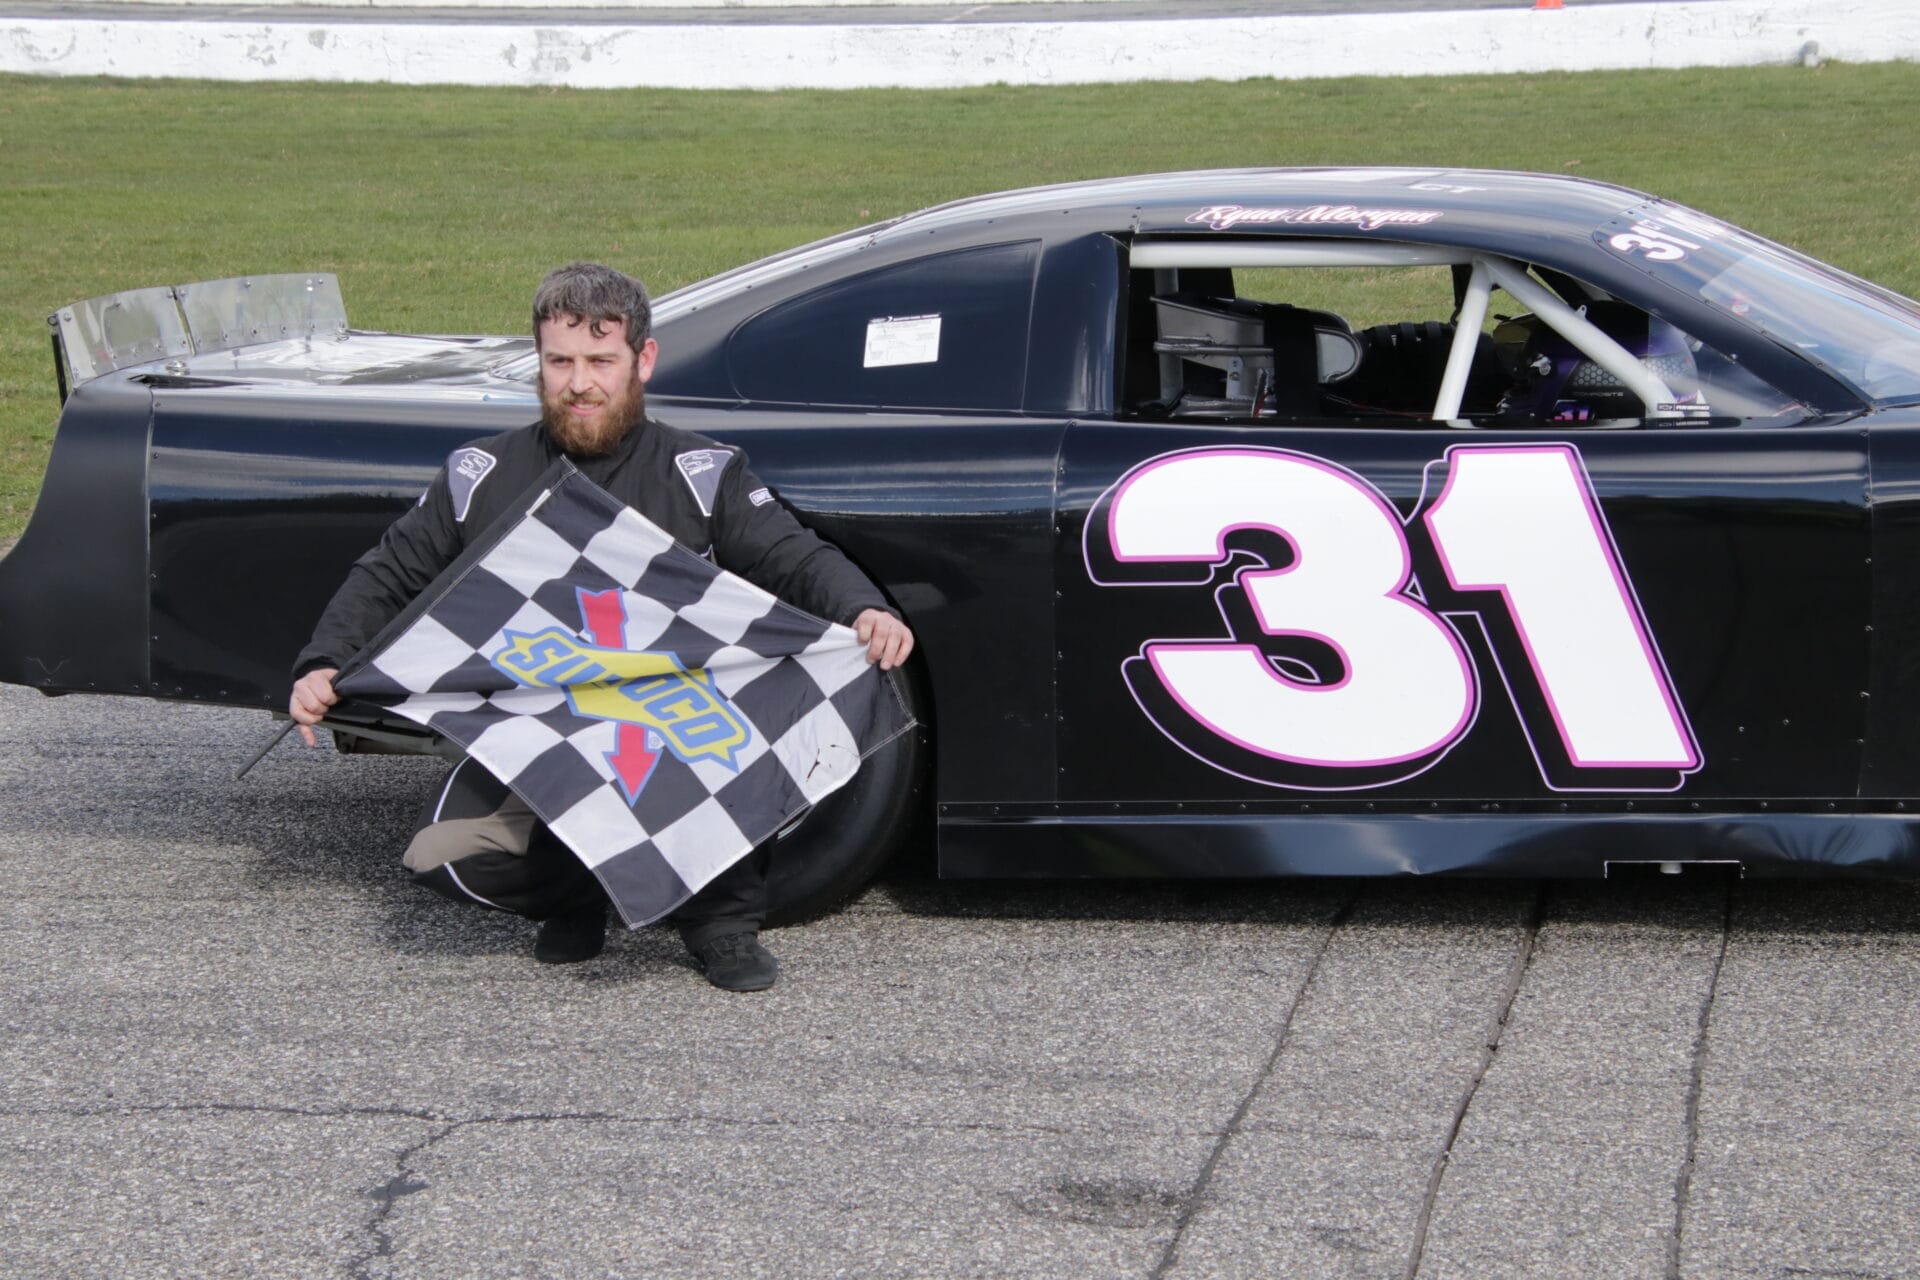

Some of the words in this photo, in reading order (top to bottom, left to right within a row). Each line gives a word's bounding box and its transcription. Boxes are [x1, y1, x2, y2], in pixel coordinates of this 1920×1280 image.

[1186, 205, 1291, 231] Ryan
[1285, 205, 1444, 231] Morgan
[1105, 446, 1702, 769] 31
